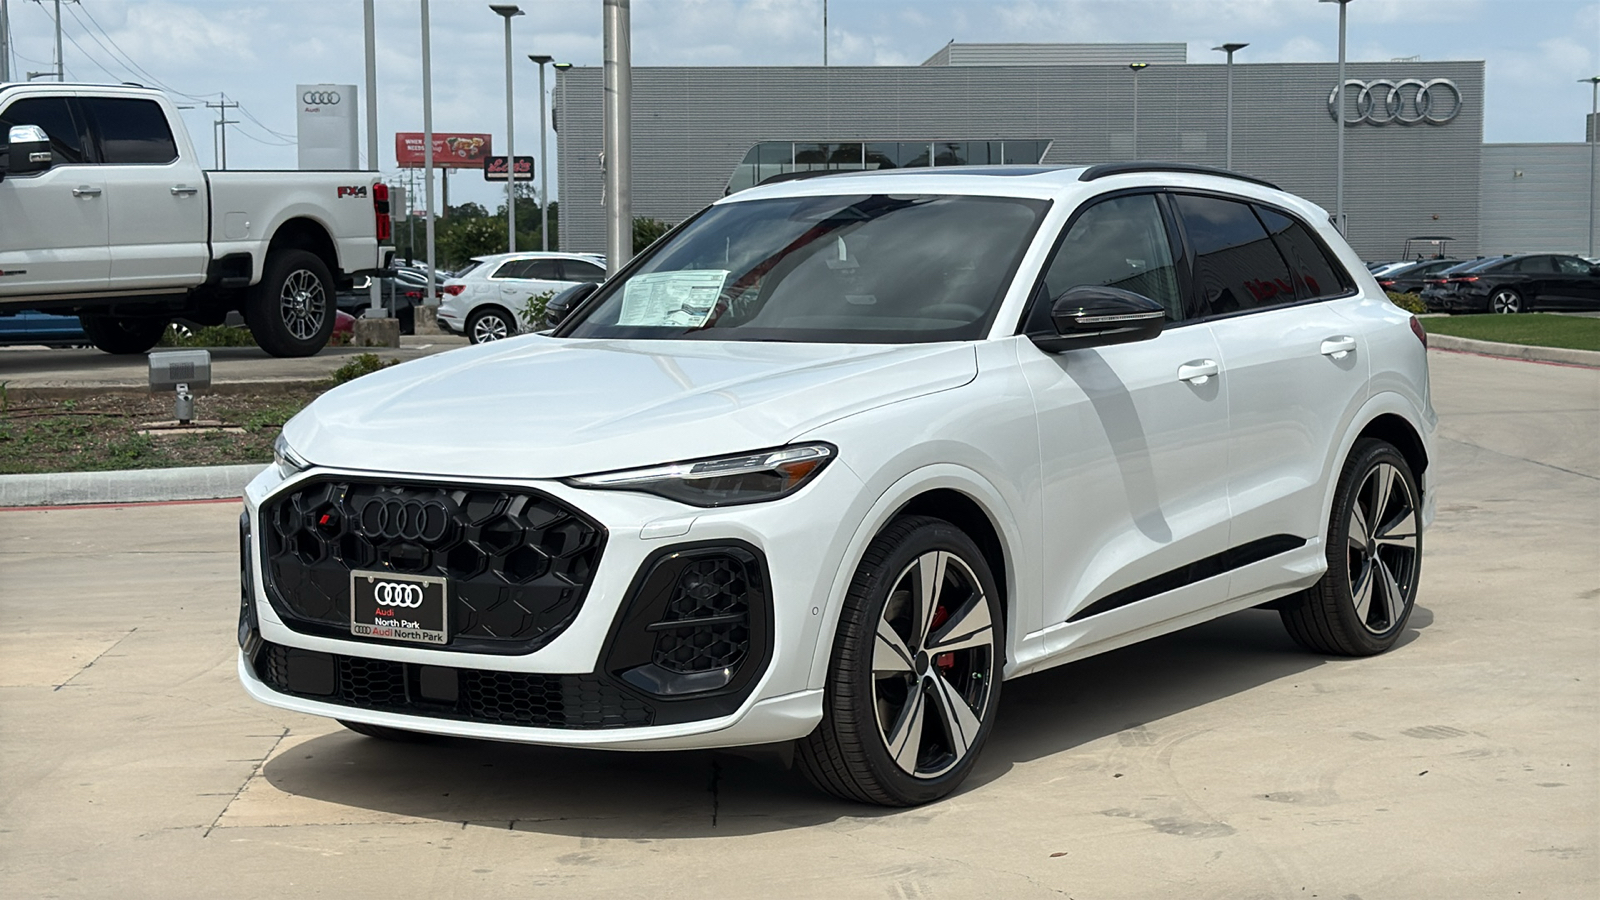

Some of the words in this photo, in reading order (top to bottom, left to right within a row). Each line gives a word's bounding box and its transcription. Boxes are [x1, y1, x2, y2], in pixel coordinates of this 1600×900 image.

[337, 186, 367, 198] FX4
[375, 608, 395, 617] Audi
[374, 617, 400, 628] North
[401, 620, 420, 629] Park
[372, 627, 393, 637] Audi
[394, 629, 421, 640] North
[422, 632, 443, 642] Park
